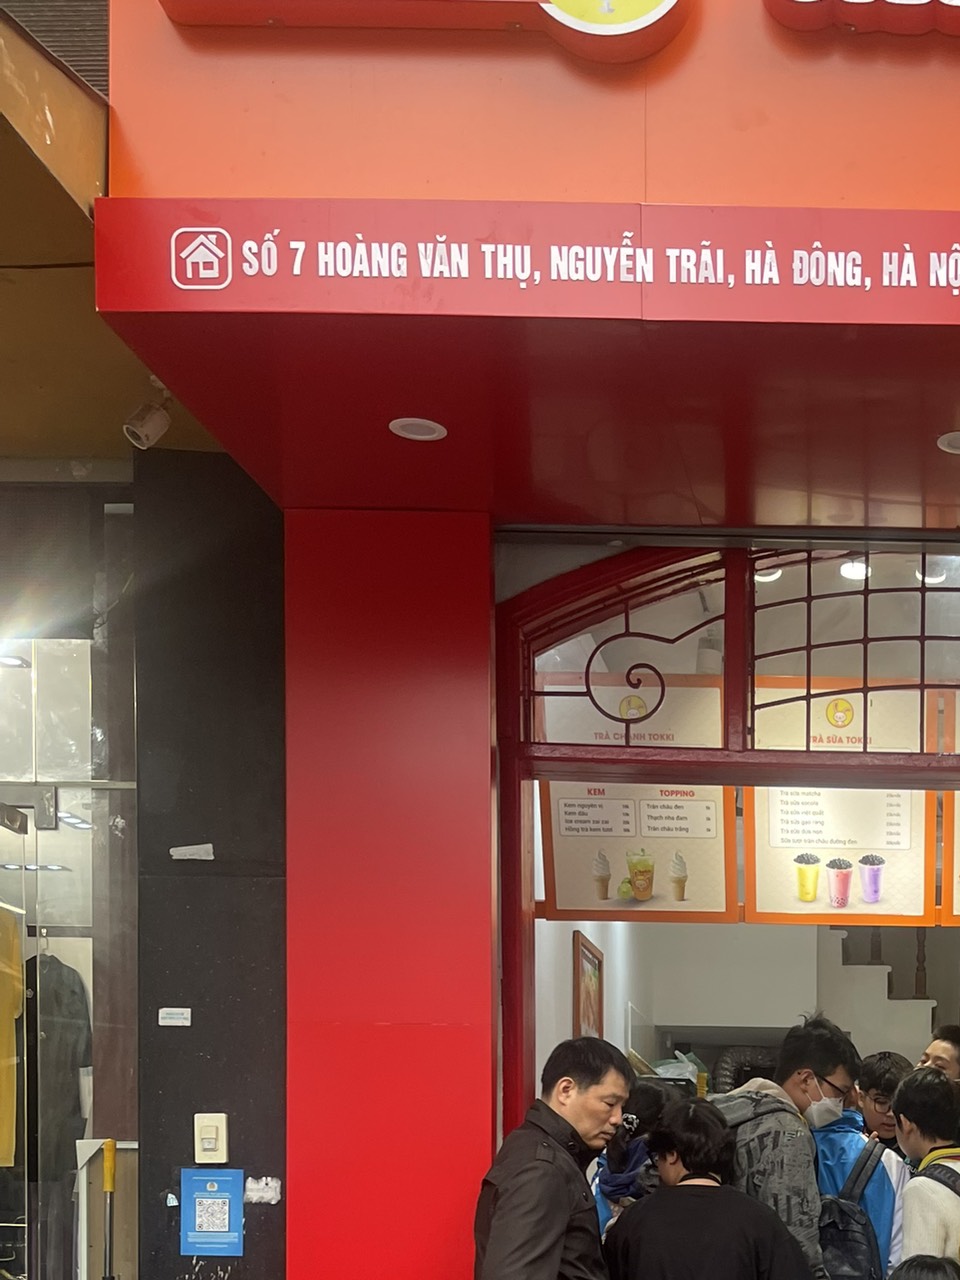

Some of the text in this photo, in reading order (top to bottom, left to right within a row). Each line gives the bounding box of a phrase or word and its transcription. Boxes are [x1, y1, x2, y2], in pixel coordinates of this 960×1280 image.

[242, 228, 281, 277] SỐ
[289, 241, 306, 276] 7
[317, 233, 408, 278] HOÀNG
[417, 234, 469, 279] VĂN
[481, 243, 541, 289] THỤ,
[550, 231, 653, 283] NGUYỄN
[666, 240, 735, 289] TRÃI,
[745, 240, 779, 286] HÀ
[792, 240, 871, 291] ĐÔNG,
[882, 243, 917, 288] HÀ
[594, 730, 610, 741] TRÀ
[647, 732, 675, 742] TOKKI
[826, 735, 843, 745] SỮA
[845, 737, 872, 745] TOKI
[587, 787, 606, 797] KEM
[659, 789, 695, 798] TOPPING
